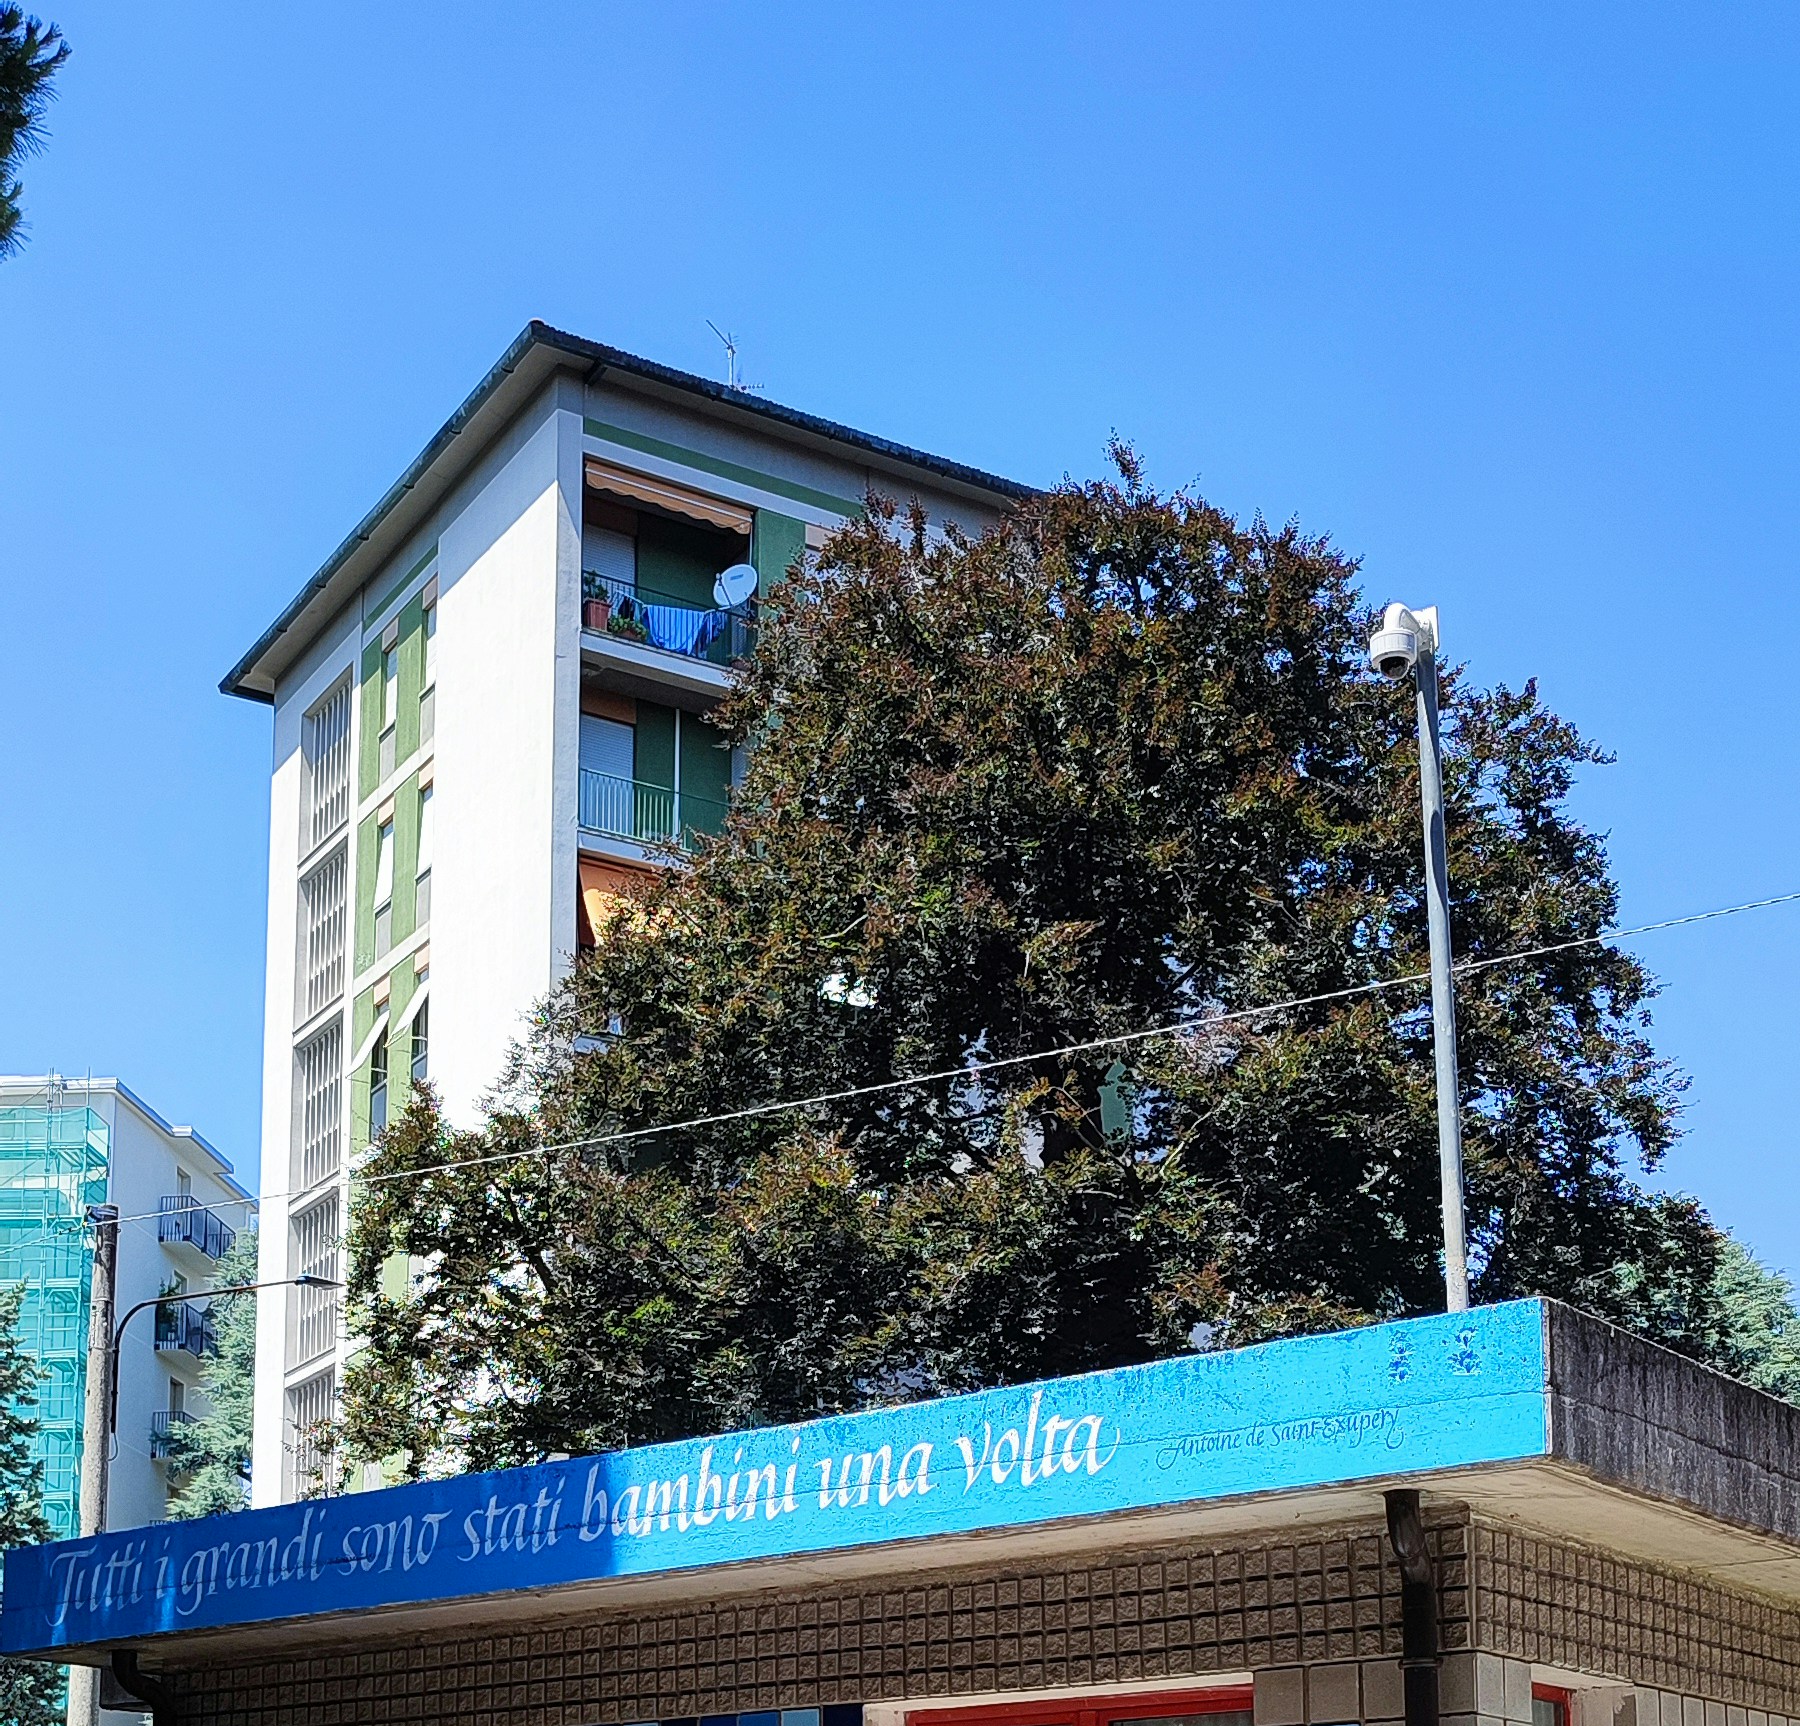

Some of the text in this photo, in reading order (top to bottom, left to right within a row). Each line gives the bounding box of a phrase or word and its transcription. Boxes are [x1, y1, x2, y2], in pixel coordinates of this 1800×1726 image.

[45, 1389, 1121, 1626] Tutti i grandi sono stati bambini una volta
[1156, 1432, 1242, 1470] Antoine
[1246, 1422, 1265, 1447] de
